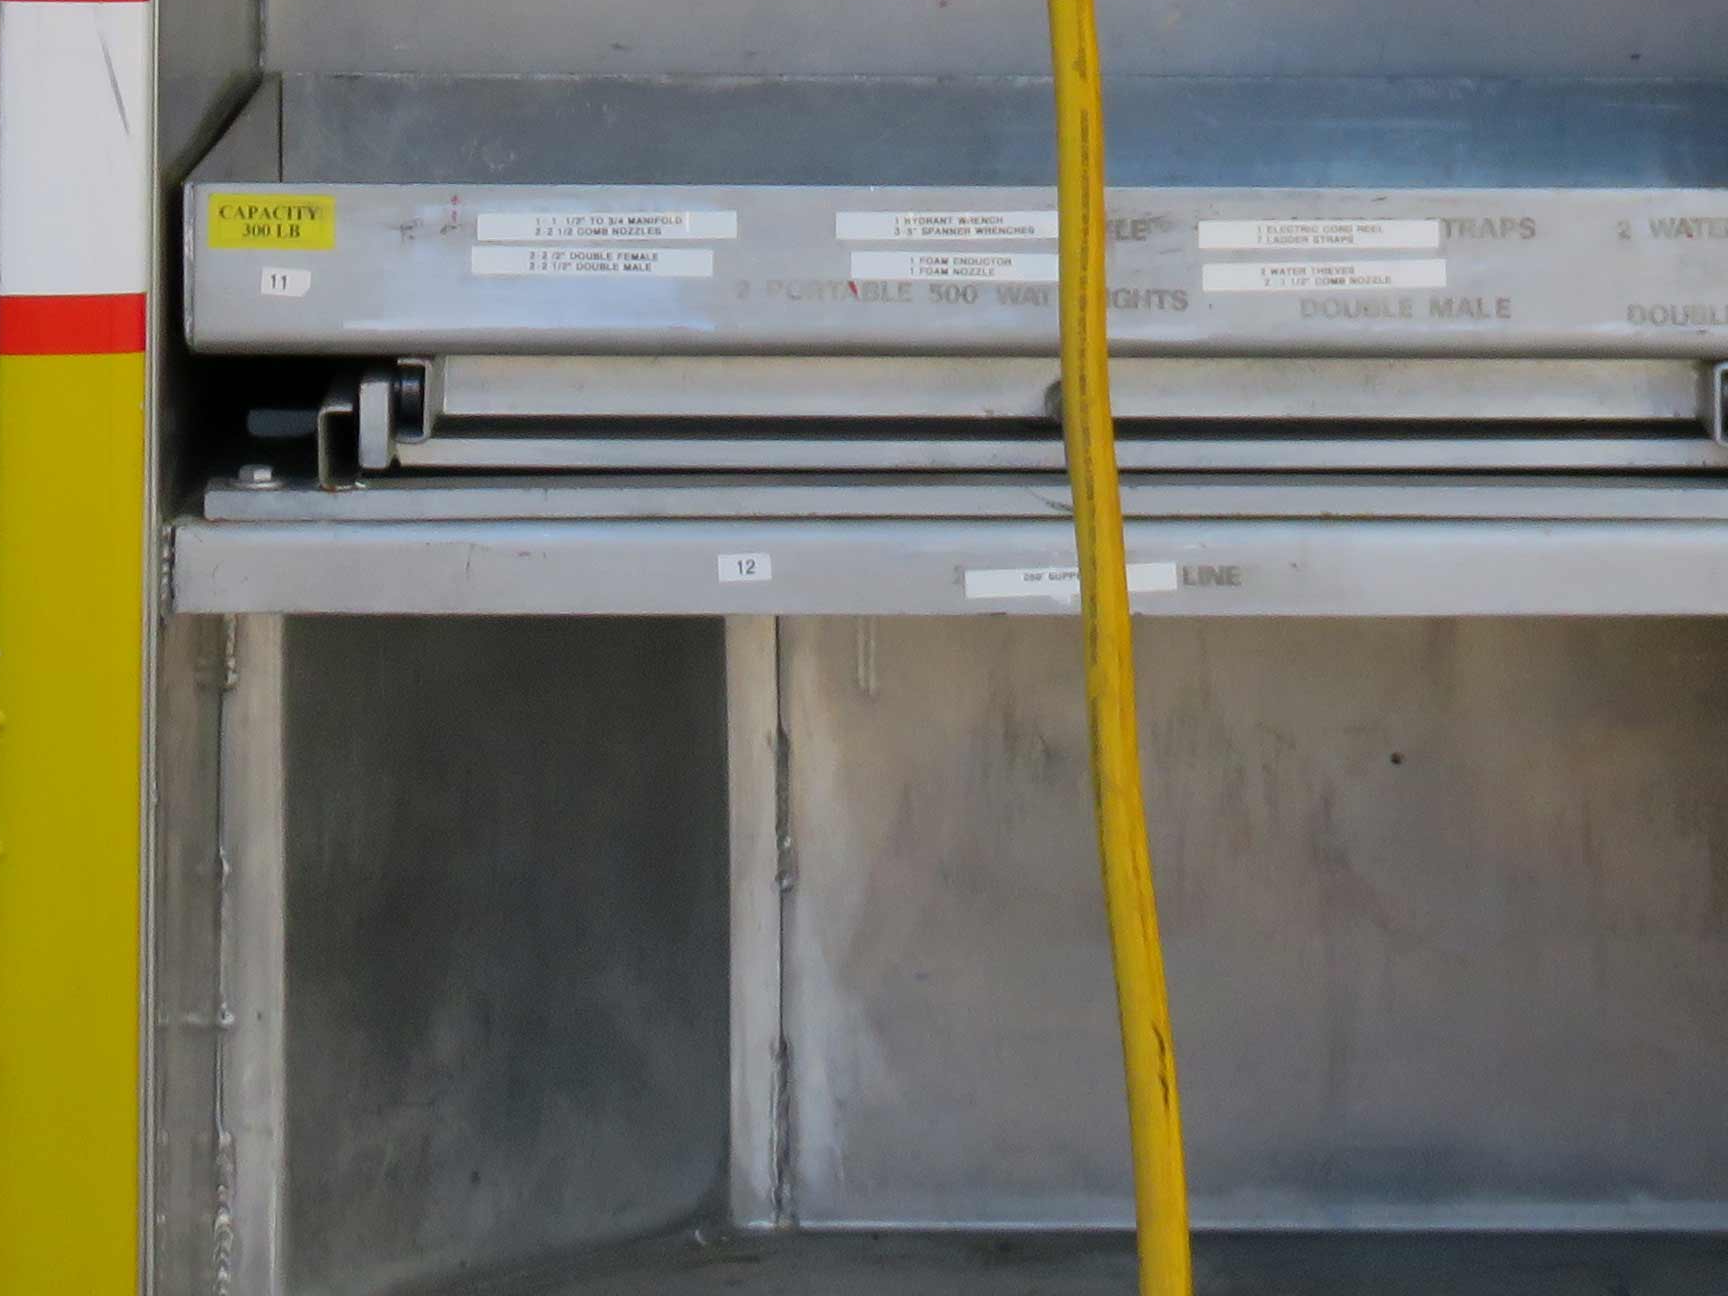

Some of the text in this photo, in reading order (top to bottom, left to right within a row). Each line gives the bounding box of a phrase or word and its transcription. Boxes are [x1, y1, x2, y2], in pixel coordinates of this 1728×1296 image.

[218, 205, 319, 221] CAPACITY
[590, 217, 604, 225] TO
[628, 216, 683, 225] MANIFOLD
[904, 216, 952, 225] HYDRANT
[958, 216, 1004, 225] WRENCH
[242, 223, 301, 239] 300 LB
[612, 227, 662, 236] NOZZLES
[922, 226, 971, 236] SPANNER
[975, 226, 1035, 235] WRENCHES
[1266, 225, 1318, 233] ELECTRIC
[1440, 216, 1537, 240] TRAPS
[1266, 235, 1309, 244] LADDER
[1313, 235, 1355, 244] STRAPS
[569, 251, 613, 260] DOUBLE
[616, 252, 659, 261] FEMALE
[919, 257, 949, 265] FOAM
[576, 262, 619, 271] DOUBLE
[622, 262, 652, 271] MALE
[1270, 267, 1307, 275] WATER
[1311, 266, 1355, 275] THIEVES
[919, 267, 949, 276] FOAM
[953, 267, 995, 277] NOZZLE
[270, 274, 287, 290] 11
[1349, 275, 1392, 285] NOZZLE
[928, 282, 979, 305] 500
[997, 285, 1051, 308] WAT
[1105, 288, 1189, 311] IGHTS
[1299, 296, 1512, 319] DOUBLE MALE
[737, 558, 756, 575] 12
[1048, 571, 1081, 581] SUPP
[1182, 564, 1242, 586] LINE
